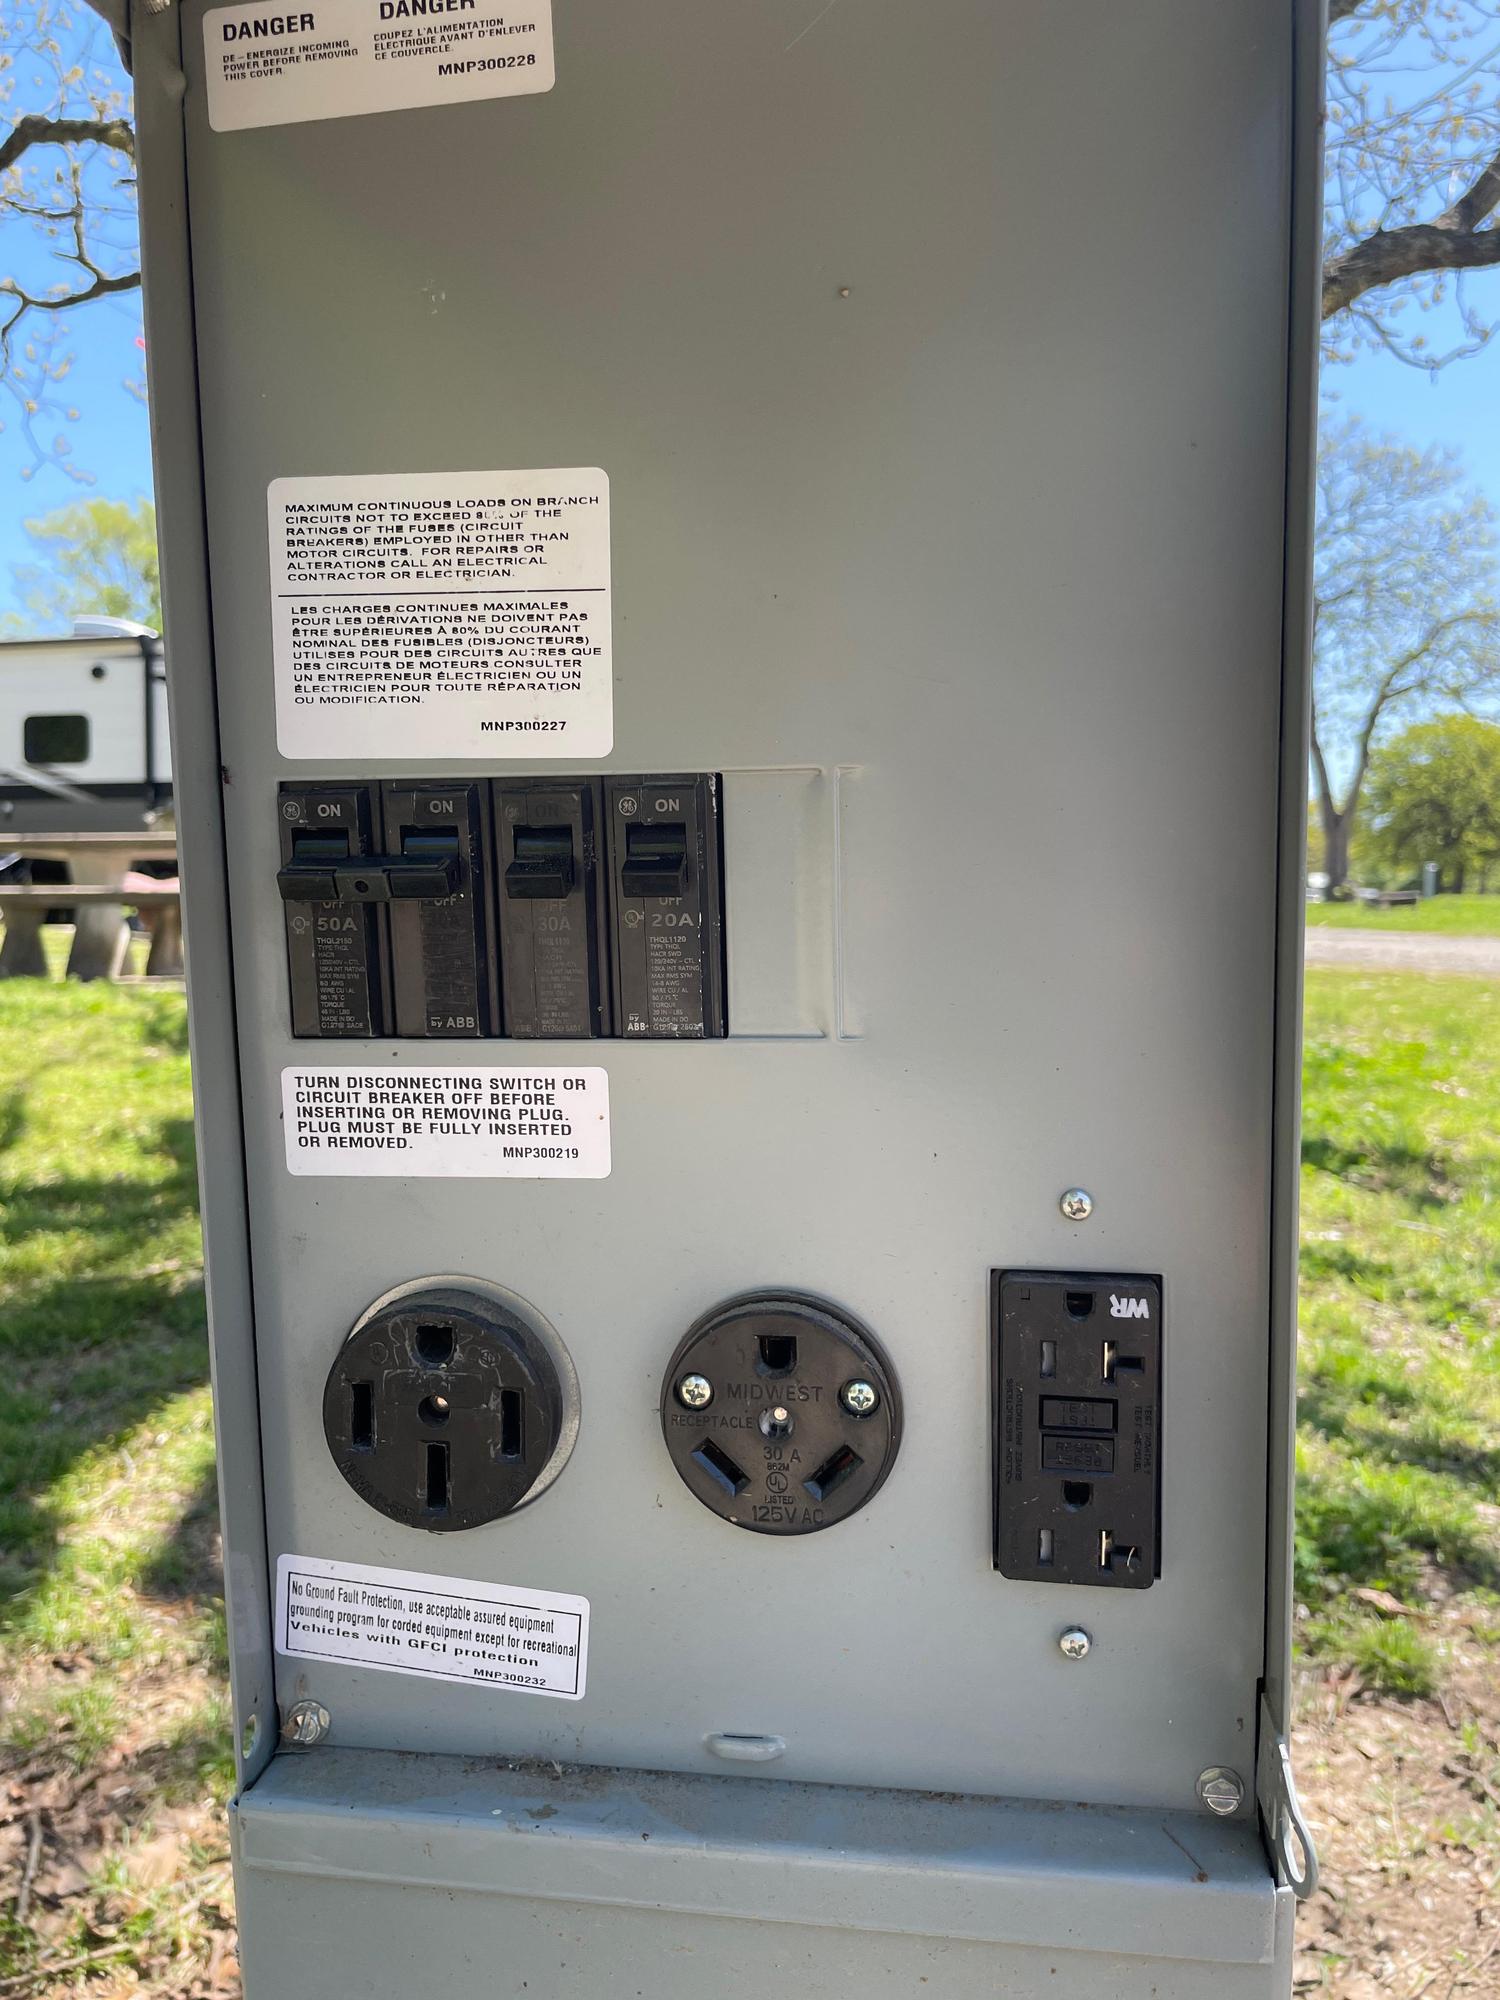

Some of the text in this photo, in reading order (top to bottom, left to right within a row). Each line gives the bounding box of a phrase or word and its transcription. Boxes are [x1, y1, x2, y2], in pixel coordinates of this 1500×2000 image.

[223, 13, 314, 42] DANGER
[374, 18, 503, 41] COUPEZ L'ALIMENTATION
[374, 24, 535, 51] ELECTRIQUE AVANT D'ENLEVER
[299, 40, 349, 53] INCOMING
[223, 48, 358, 72] POWER BEFORE REMOVING
[375, 52, 386, 60] CE
[438, 54, 535, 76] MNP300228
[224, 72, 246, 81] THIS
[285, 503, 353, 513] MAXIMUM
[357, 500, 451, 511] CONTINUOUS
[457, 499, 506, 508] LOADS
[511, 498, 531, 506] ON
[285, 509, 561, 524] CIRCUITS NOT TO EXCEED THE
[286, 522, 523, 536] RATINGS OF THE FUSES (CIRCUIT
[286, 532, 569, 547] BREAKERS) EMPLOYED IN OTHER THAN
[287, 550, 338, 559] MOTOR
[422, 547, 450, 556] FOR
[456, 545, 518, 555] REPAIRS
[524, 545, 544, 553] OR
[287, 556, 547, 570] ALTERATIONS CALL AN ELECTRICAL
[288, 572, 385, 581] CONTRACTOR
[391, 571, 411, 579] OR
[291, 602, 568, 615] LES CHARGES CONTINUES MAXIMALES
[292, 617, 331, 626] POUR
[336, 617, 362, 625] LES
[468, 615, 486, 623] NE
[491, 613, 554, 622] DOIVENT
[559, 613, 588, 621] PAS
[452, 626, 479, 634] 80%
[485, 626, 504, 634] DU
[509, 625, 580, 633] COURANT
[293, 636, 589, 648] NOMINAL DES FUSIBLES (DISJONCTEURS)
[360, 650, 399, 658] POUR
[404, 650, 432, 658] DES
[437, 649, 503, 657] CIRCUITS
[571, 647, 601, 656] QUE
[293, 659, 582, 671] DES CIRCUITS DE MOTEURS CONSULTER
[294, 674, 313, 682] UN
[318, 672, 432, 682] ENTREPRENEUR
[536, 671, 556, 679] OU
[562, 671, 581, 679] UN
[391, 684, 430, 692] POUR
[436, 683, 482, 691] TOUTE
[295, 696, 314, 704] OU
[481, 721, 566, 731] MNP300227
[317, 804, 341, 818] ON
[429, 800, 454, 814] ON
[655, 799, 680, 812] ON
[317, 917, 358, 931] 50A
[651, 912, 694, 927] 20A
[430, 1016, 475, 1029] by ABB
[627, 1022, 646, 1031] ABB
[294, 1076, 586, 1090] TURN DISCONNECTING SWITCH OR
[296, 1091, 555, 1105] CIRCUIT BREAKER OFF BEFORE
[297, 1106, 385, 1119] INSERTING
[392, 1107, 415, 1119] OR
[422, 1107, 511, 1120] REMOVING
[298, 1121, 571, 1136] PLUG MUST BE FULLY INSERTED
[298, 1136, 320, 1147] OR
[503, 1147, 579, 1159] MNP300219
[727, 1383, 824, 1403] MIDWEST
[670, 1414, 753, 1429] RECEPTACLE
[763, 1446, 802, 1463] 30 A
[764, 1495, 794, 1505] LISTED
[292, 1581, 554, 1634] No Ground Fault Protection, use acceptable assured equipment
[290, 1604, 576, 1657] grounding program for corded equipment except for recreational
[291, 1620, 538, 1667] Vehicles with GFCI protection
[473, 1667, 546, 1686] MNP300232
